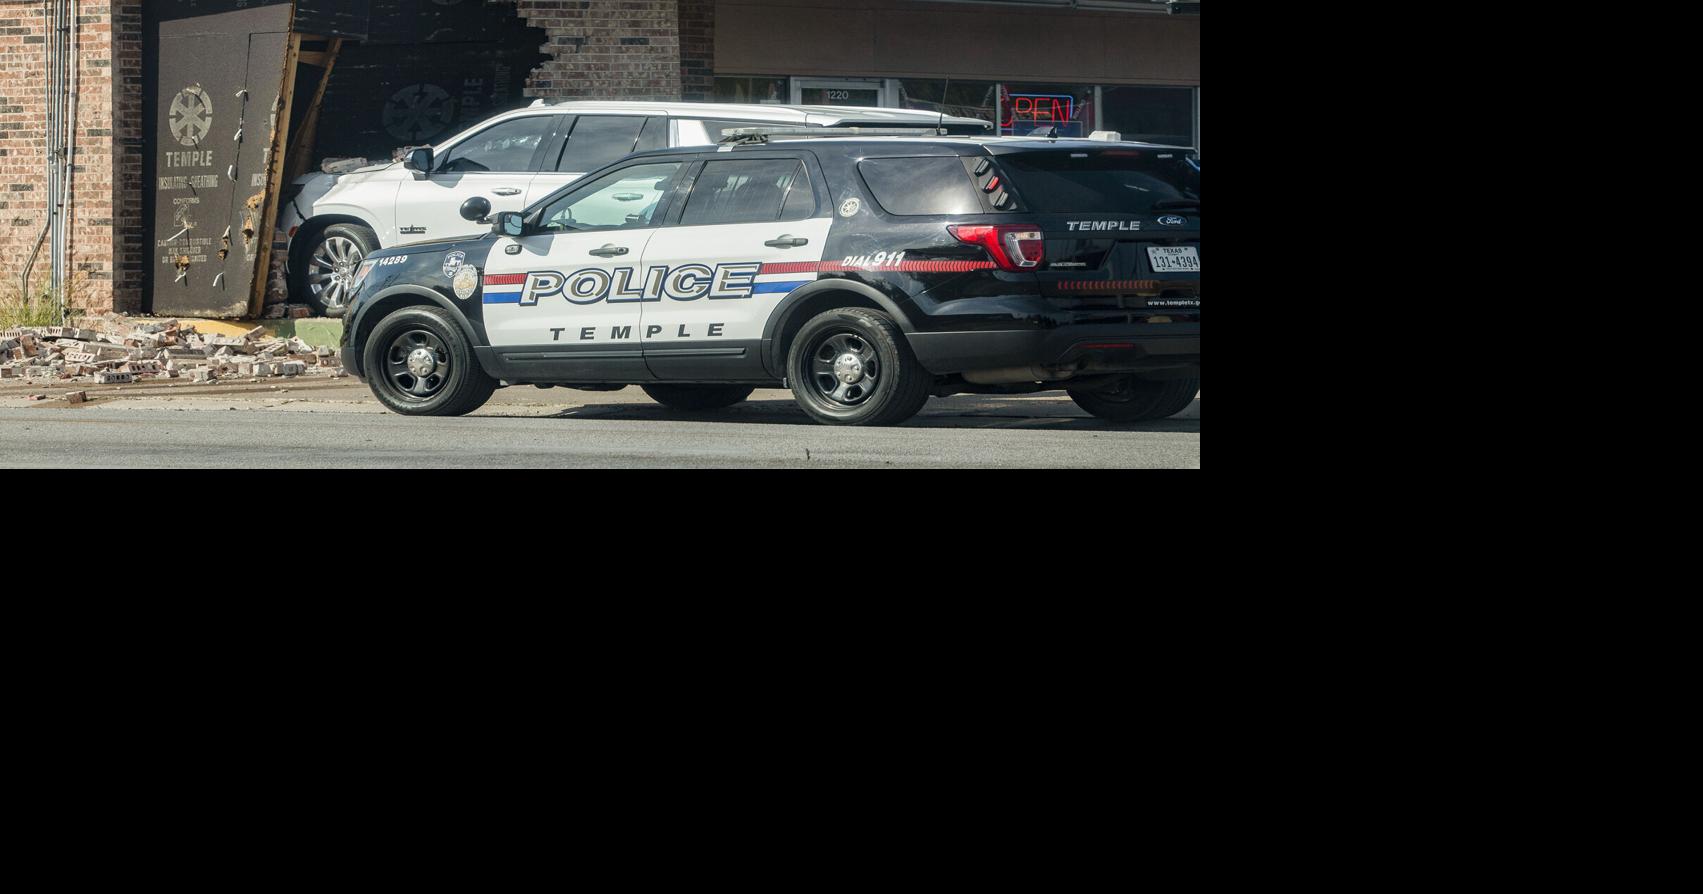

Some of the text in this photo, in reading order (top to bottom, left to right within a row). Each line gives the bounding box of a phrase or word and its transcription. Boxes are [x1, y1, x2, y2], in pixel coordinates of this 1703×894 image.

[825, 90, 849, 100] 1220
[166, 151, 213, 168] TEMPLE
[1066, 220, 1141, 231] TEMPLE
[379, 255, 408, 266] 14289
[841, 251, 906, 267] DIAL 911
[518, 262, 762, 306] POLICE
[550, 322, 725, 341] TEMPLE
